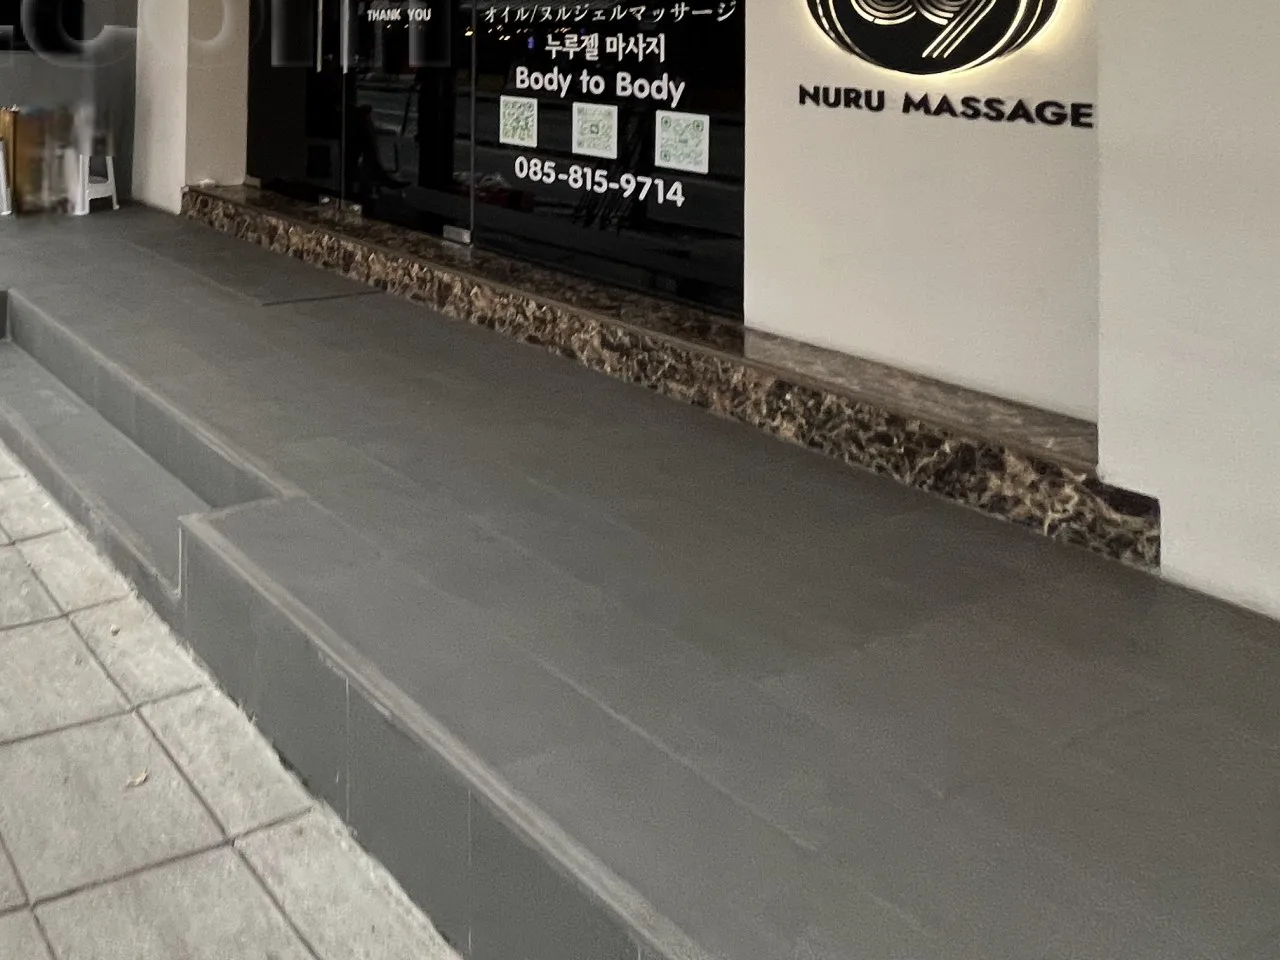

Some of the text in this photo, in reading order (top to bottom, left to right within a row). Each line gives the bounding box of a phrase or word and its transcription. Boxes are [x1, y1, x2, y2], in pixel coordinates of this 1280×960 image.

[367, 8, 432, 22] THANK YOU
[544, 32, 667, 63] 누루젤 마사지
[516, 66, 686, 109] Body to Body
[798, 84, 1094, 129] NURU MASSAGE
[514, 156, 686, 208] 085-815-9714
